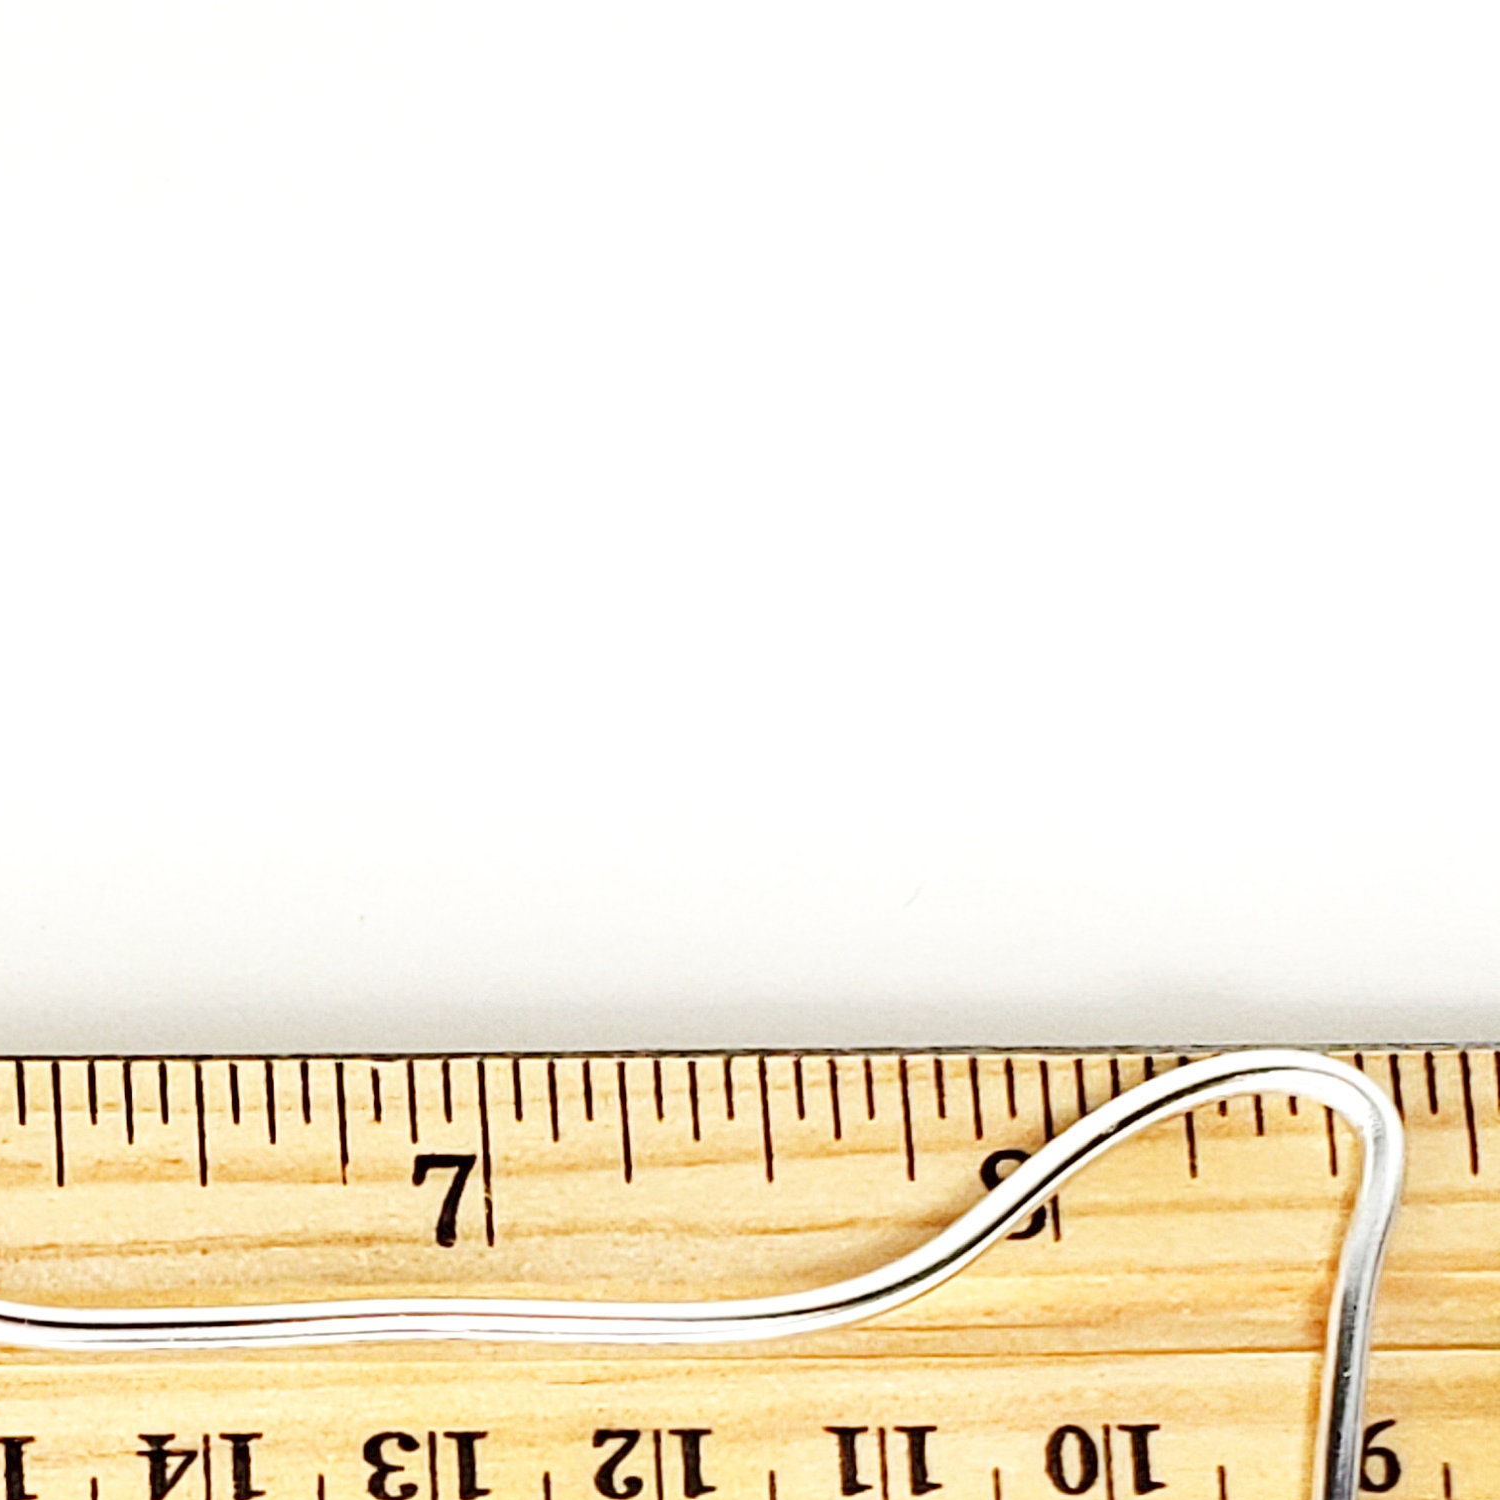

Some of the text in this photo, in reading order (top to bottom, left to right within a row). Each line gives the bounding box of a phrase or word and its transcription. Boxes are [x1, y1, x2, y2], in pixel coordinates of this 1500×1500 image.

[411, 1153, 477, 1248] 7
[592, 1428, 717, 1500] 12
[824, 1425, 943, 1497] 11
[1045, 1424, 1167, 1496] 10
